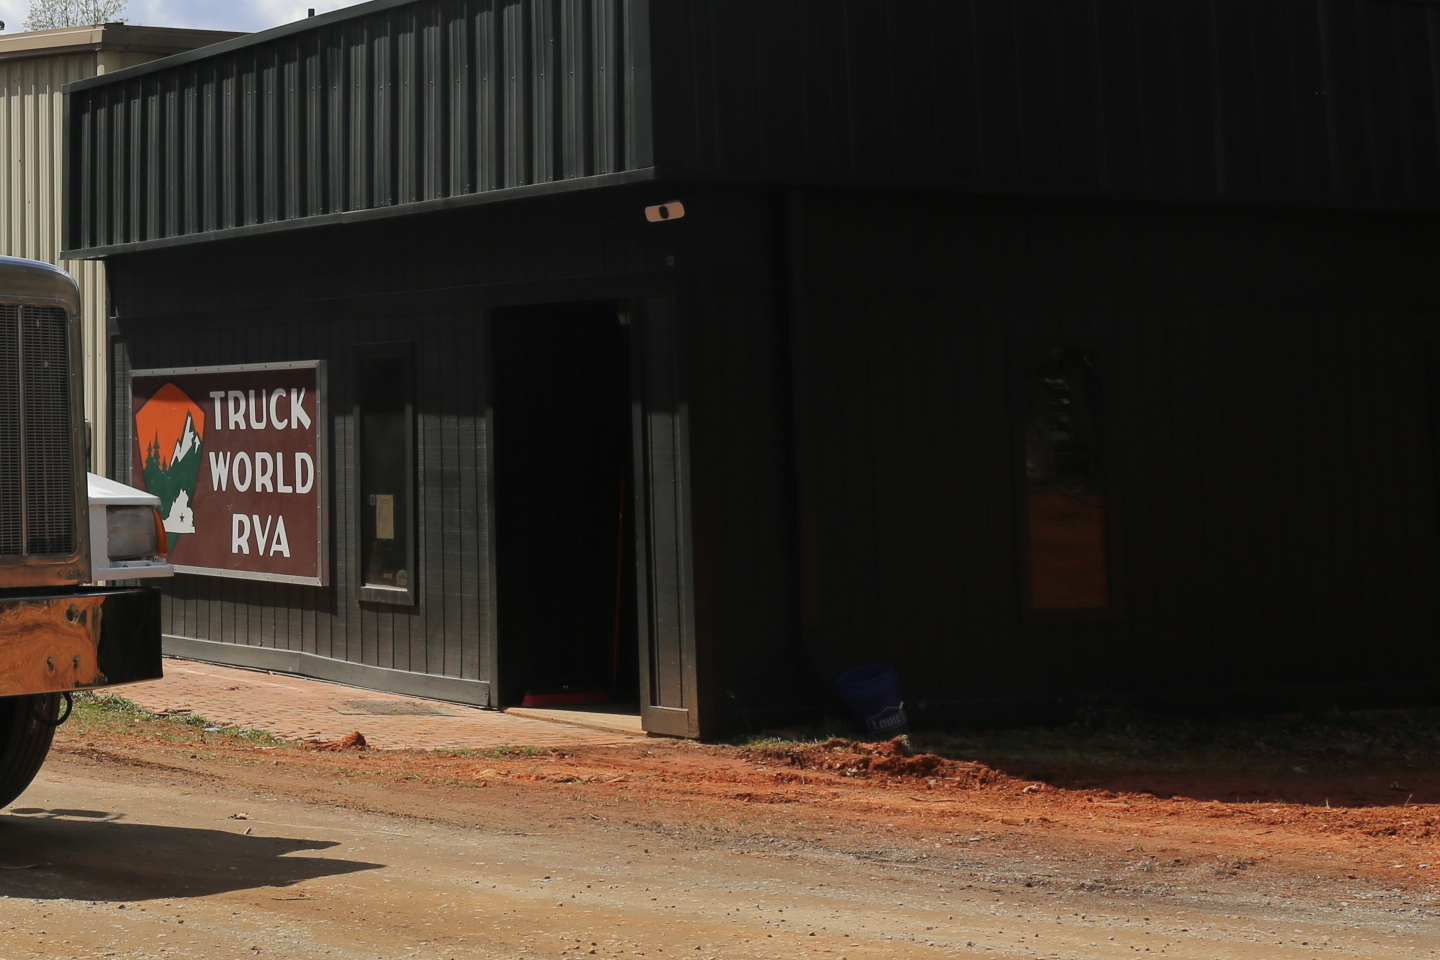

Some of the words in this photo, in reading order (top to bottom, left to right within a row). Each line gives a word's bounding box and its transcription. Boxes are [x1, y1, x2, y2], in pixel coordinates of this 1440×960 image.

[209, 388, 312, 431] TRUCK
[208, 450, 315, 495] WORLD
[231, 513, 291, 559] RVA
